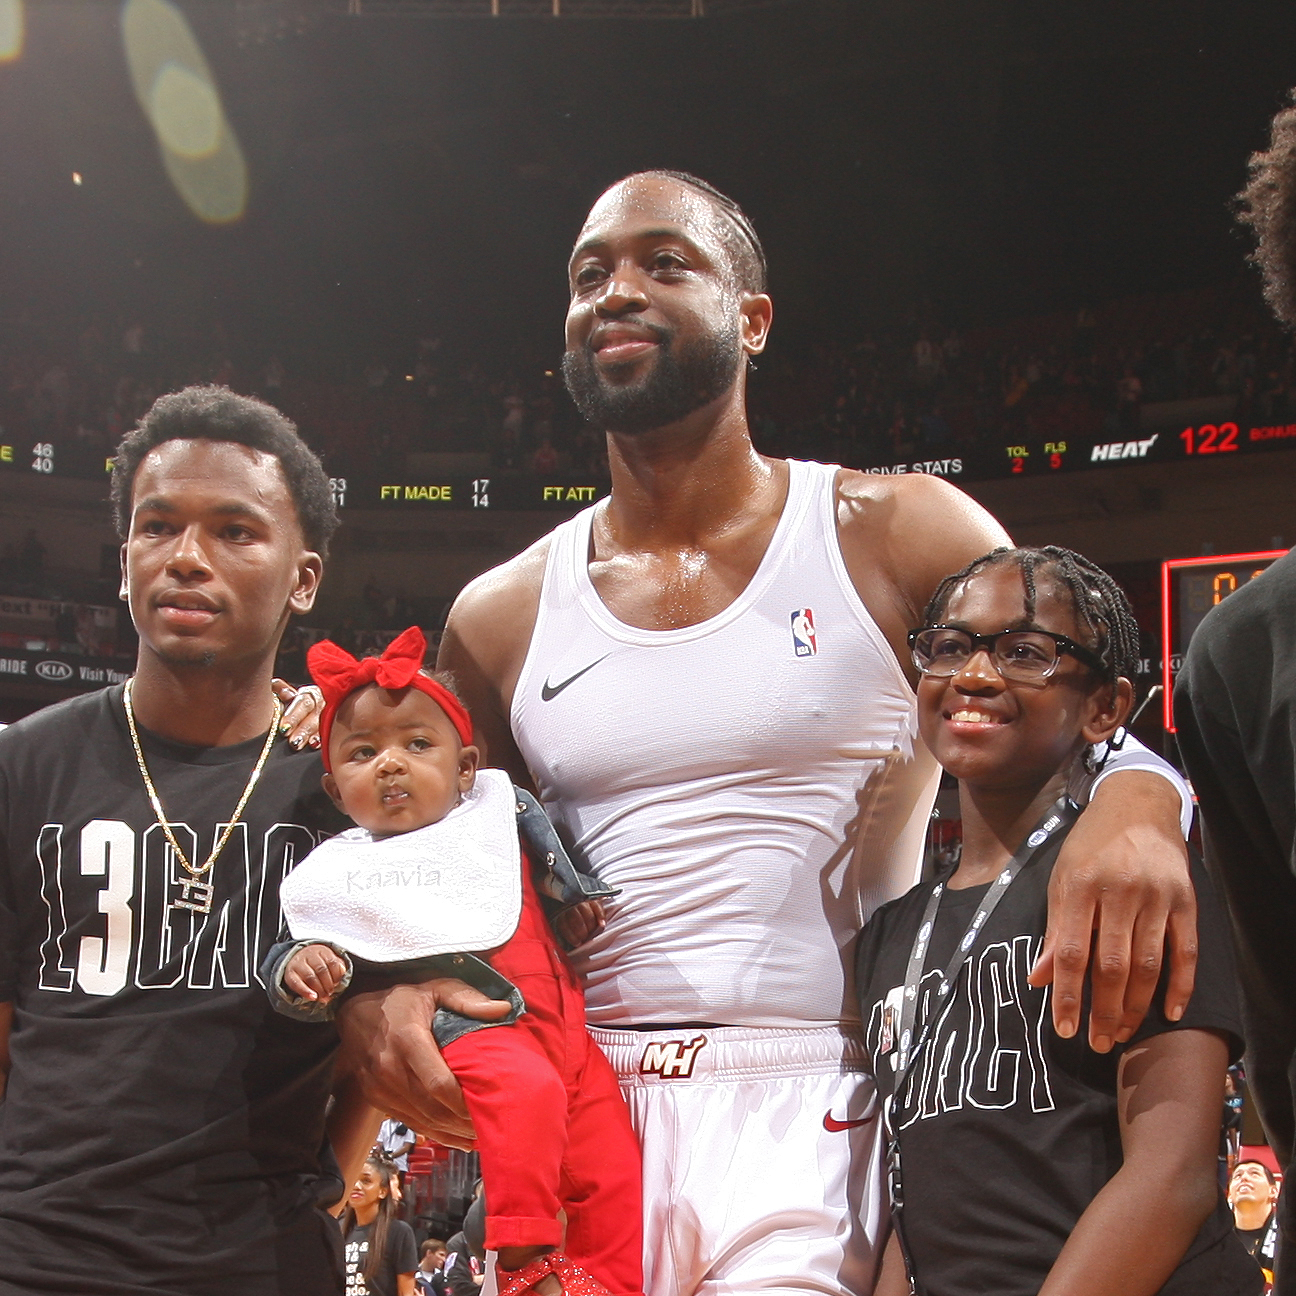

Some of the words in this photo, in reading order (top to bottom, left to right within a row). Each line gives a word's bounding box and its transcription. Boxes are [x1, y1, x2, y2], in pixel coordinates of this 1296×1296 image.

[1179, 422, 1240, 455] 122
[32, 442, 53, 458] 46
[1007, 446, 1029, 458] TOL
[1044, 441, 1066, 453] FLS
[1091, 434, 1159, 462] HEAT
[32, 458, 53, 474] 40
[912, 459, 963, 474] STATS
[1012, 458, 1023, 473] 2
[1050, 454, 1062, 469] 5
[381, 486, 401, 500] FT
[404, 486, 452, 500] MADE
[472, 479, 489, 493] 17
[543, 487, 563, 500] FT
[566, 487, 596, 500] ATT
[471, 493, 489, 507] 14
[79, 666, 104, 681] Visit
